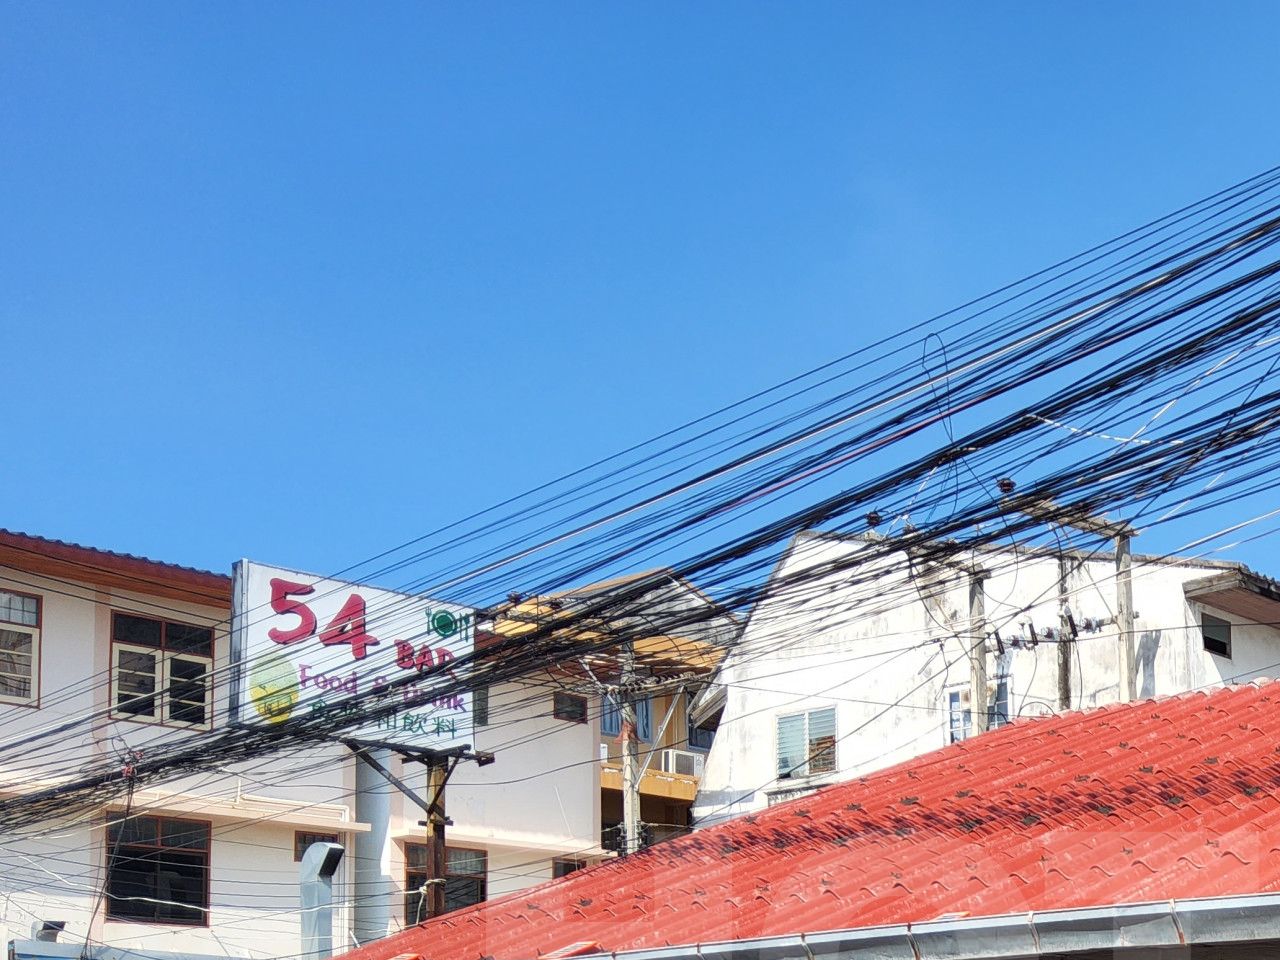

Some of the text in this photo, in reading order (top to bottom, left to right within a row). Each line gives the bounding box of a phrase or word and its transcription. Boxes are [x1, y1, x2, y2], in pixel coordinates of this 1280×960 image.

[269, 577, 457, 682] 54 BAR
[298, 664, 357, 695] Food
[402, 681, 467, 712] Dink
